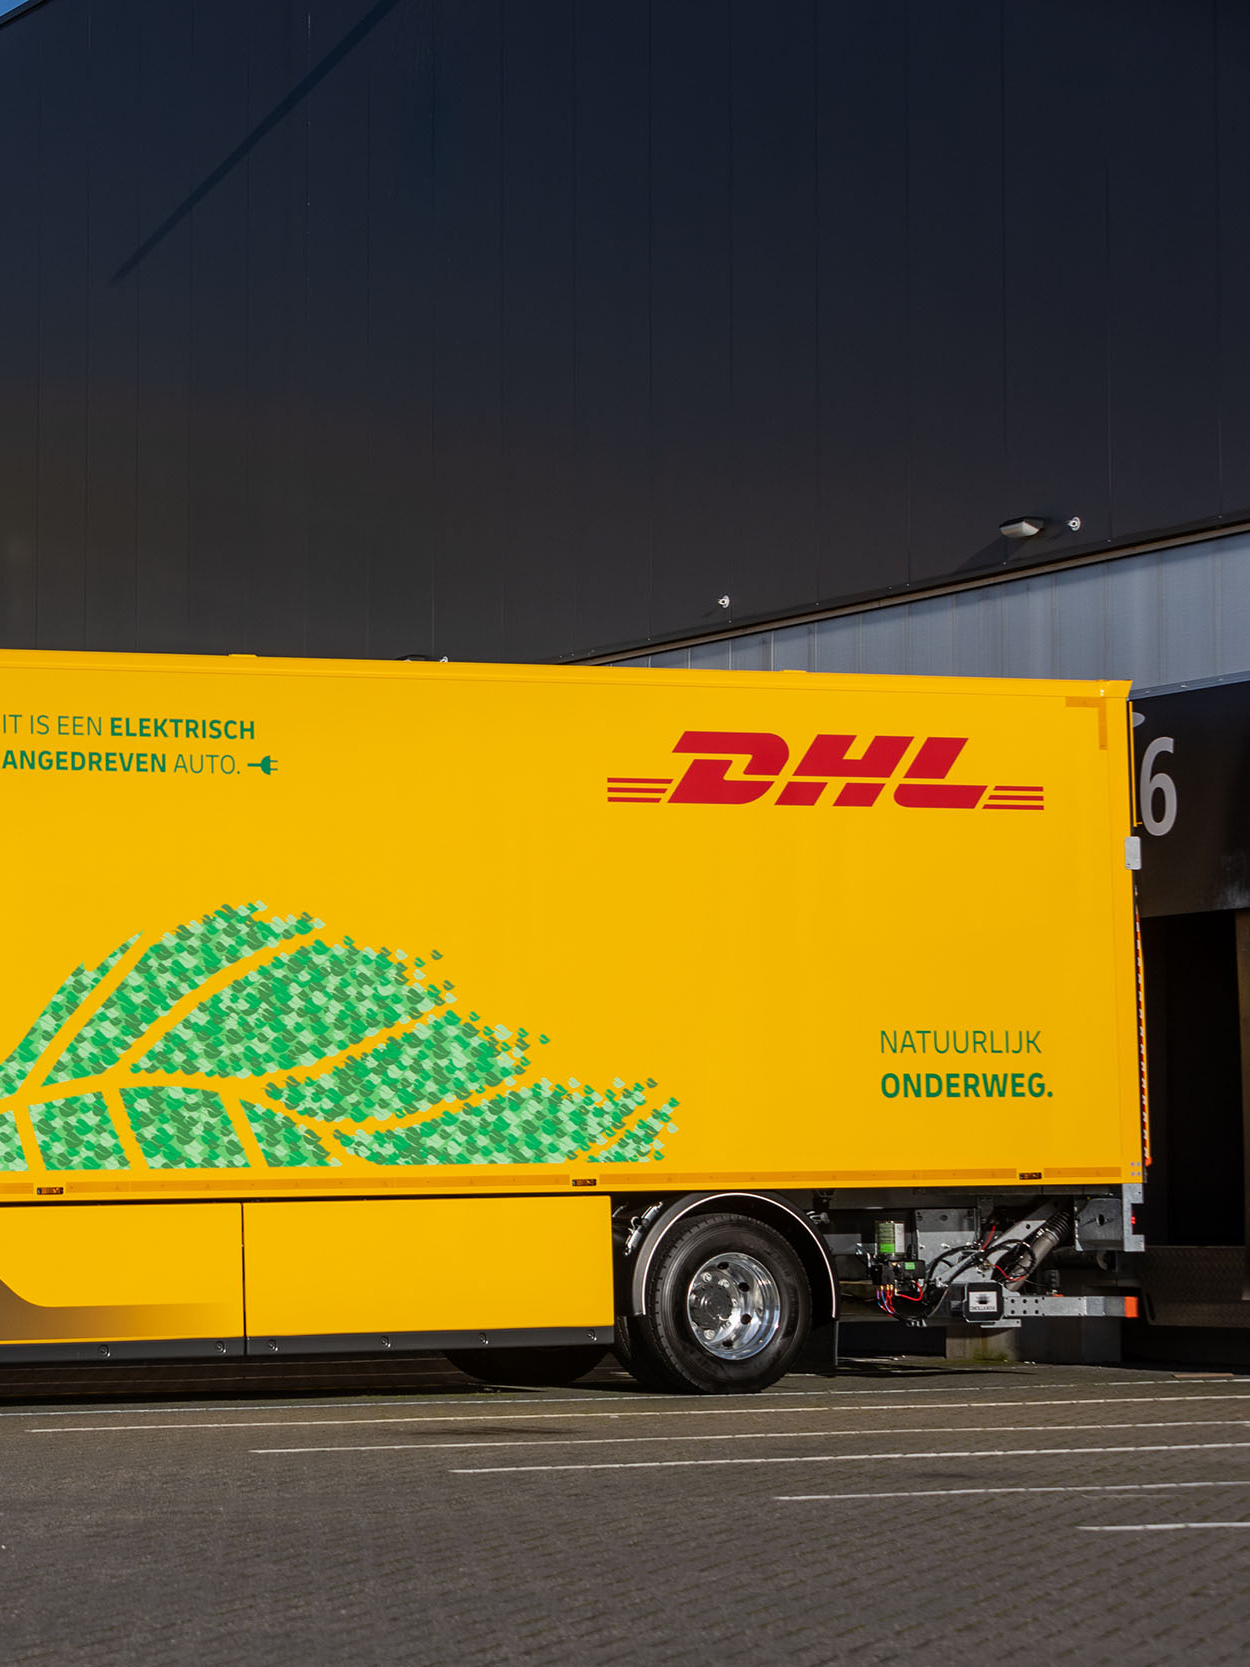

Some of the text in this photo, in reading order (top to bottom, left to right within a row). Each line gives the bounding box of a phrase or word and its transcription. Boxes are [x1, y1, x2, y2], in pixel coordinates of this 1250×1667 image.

[30, 714, 50, 735] IS
[57, 715, 102, 736] EEN
[110, 717, 255, 740] ELEKTRISCH
[173, 753, 241, 775] AUTO.
[667, 730, 989, 809] DHL
[1140, 736, 1177, 836] 6
[880, 1030, 1042, 1054] NATUURLIJK
[881, 1072, 1054, 1099] ONDERWEG.
